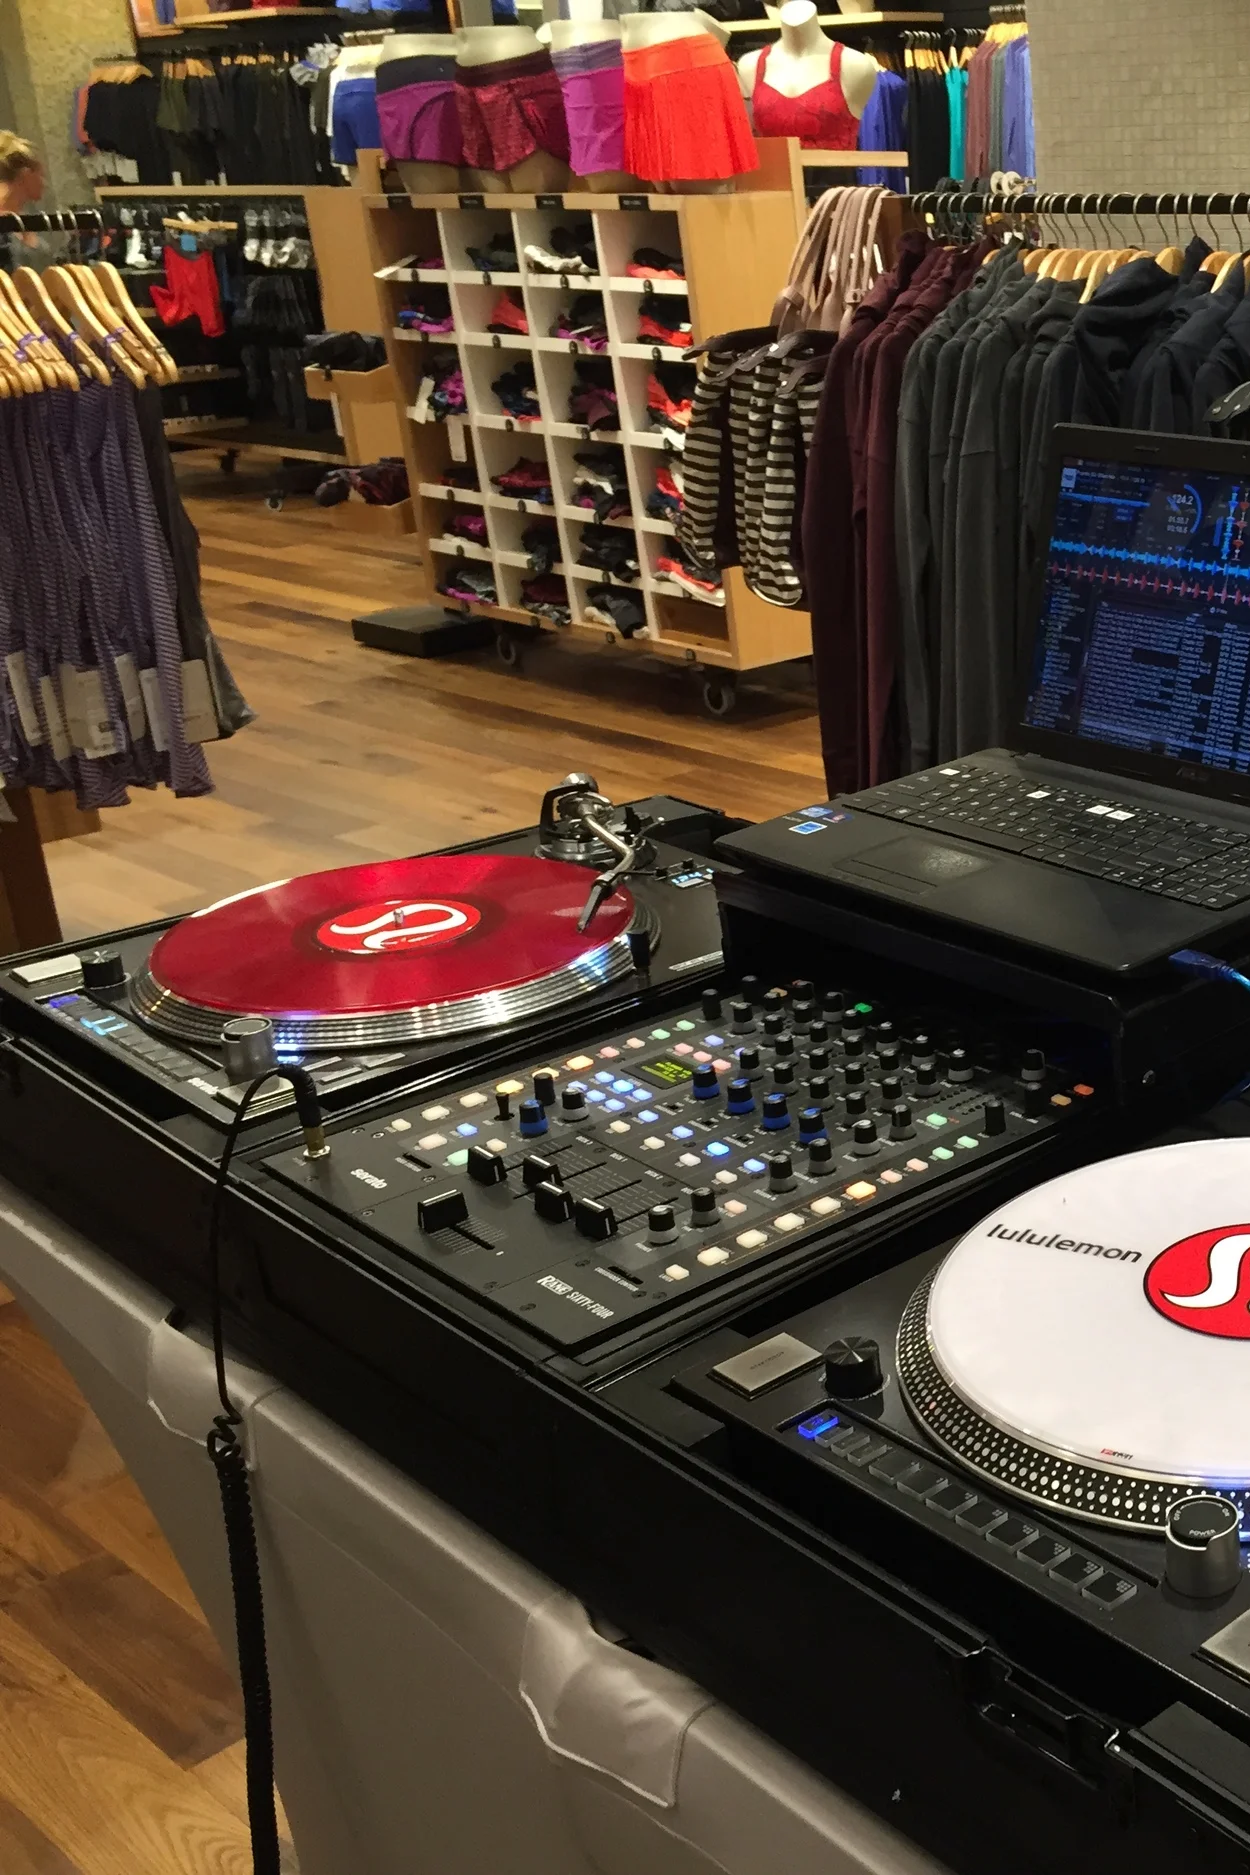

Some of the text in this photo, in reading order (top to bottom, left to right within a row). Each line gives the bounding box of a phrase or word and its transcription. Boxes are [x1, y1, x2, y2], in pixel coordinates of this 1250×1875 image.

[350, 1168, 388, 1190] serato
[986, 1223, 1142, 1264] lululemon
[536, 1274, 574, 1296] RANE
[565, 1290, 615, 1320] SIXTY-FOUR
[1188, 1528, 1217, 1537] POWER
